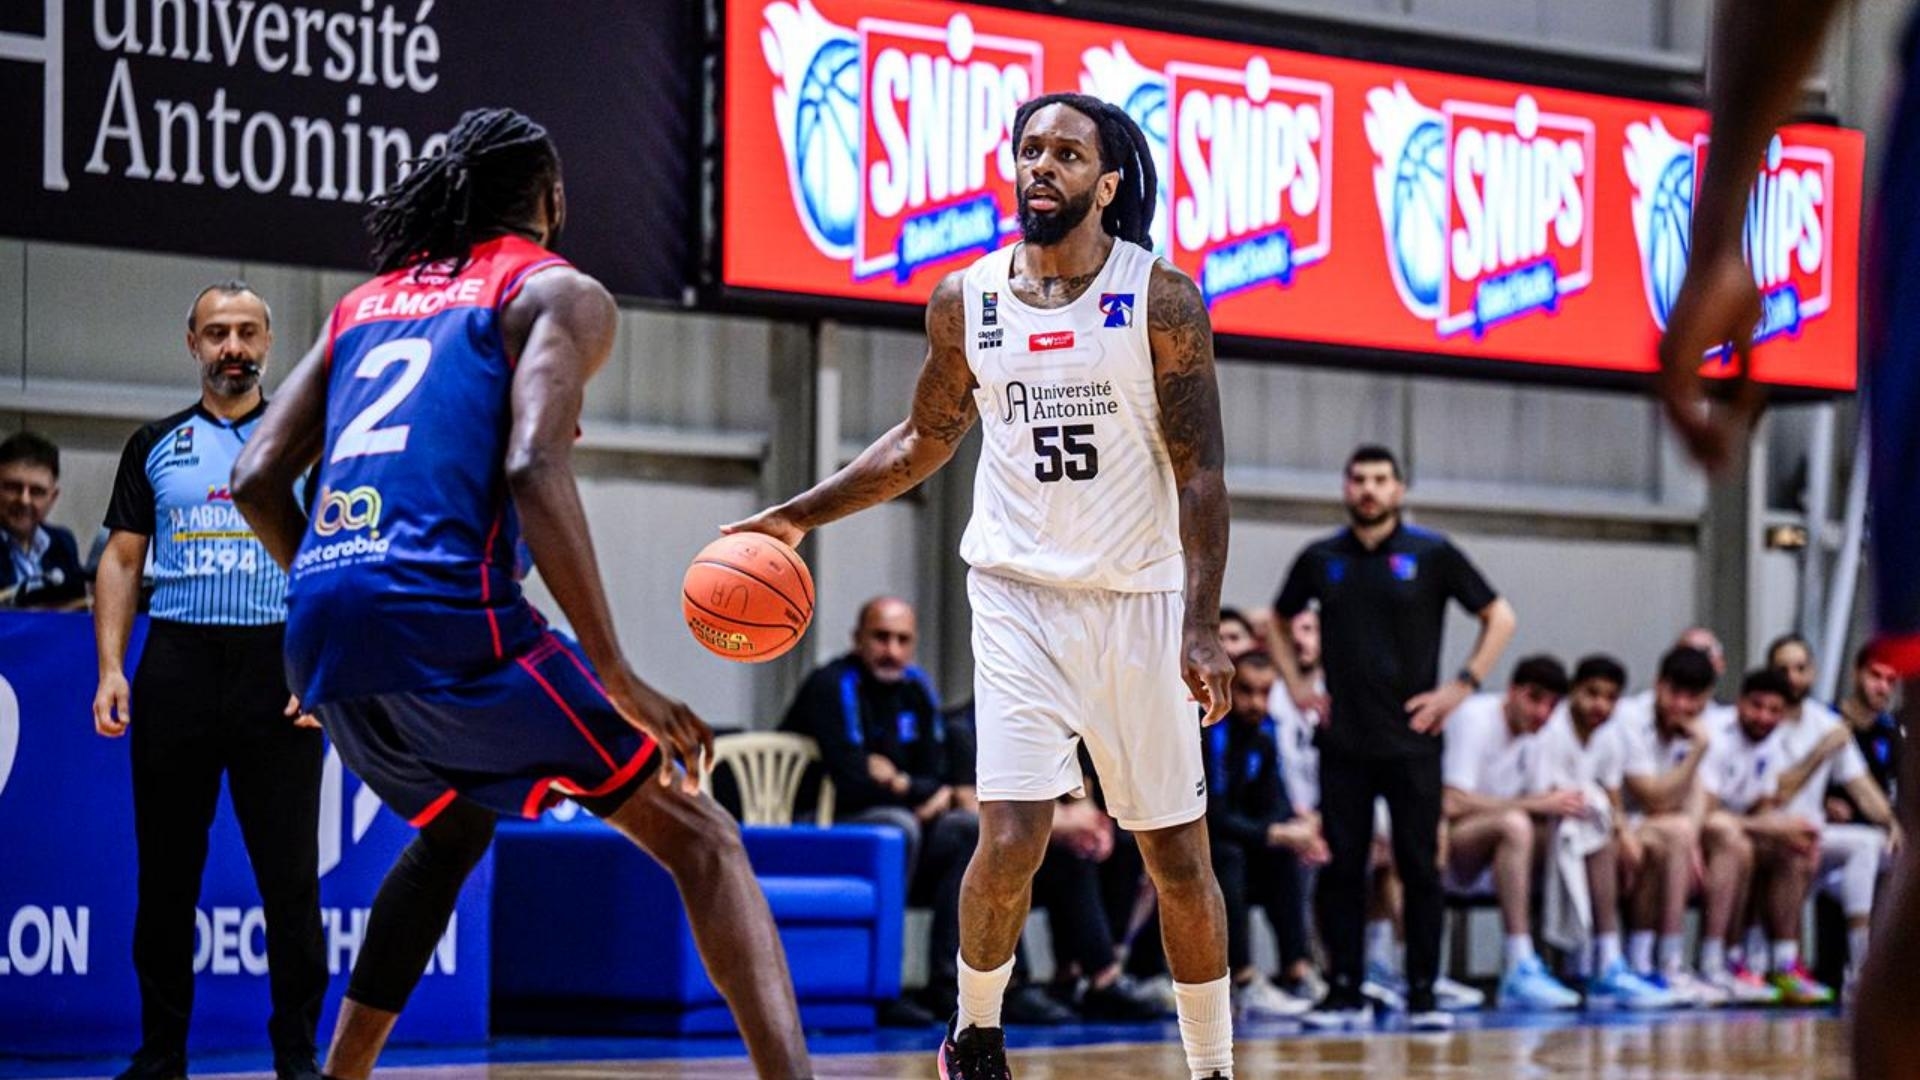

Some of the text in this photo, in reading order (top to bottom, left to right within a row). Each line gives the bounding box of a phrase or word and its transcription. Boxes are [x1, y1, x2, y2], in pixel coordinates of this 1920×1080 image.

[330, 338, 432, 464] 2
[1033, 399, 1118, 420] Antonine
[1032, 424, 1098, 483] 55
